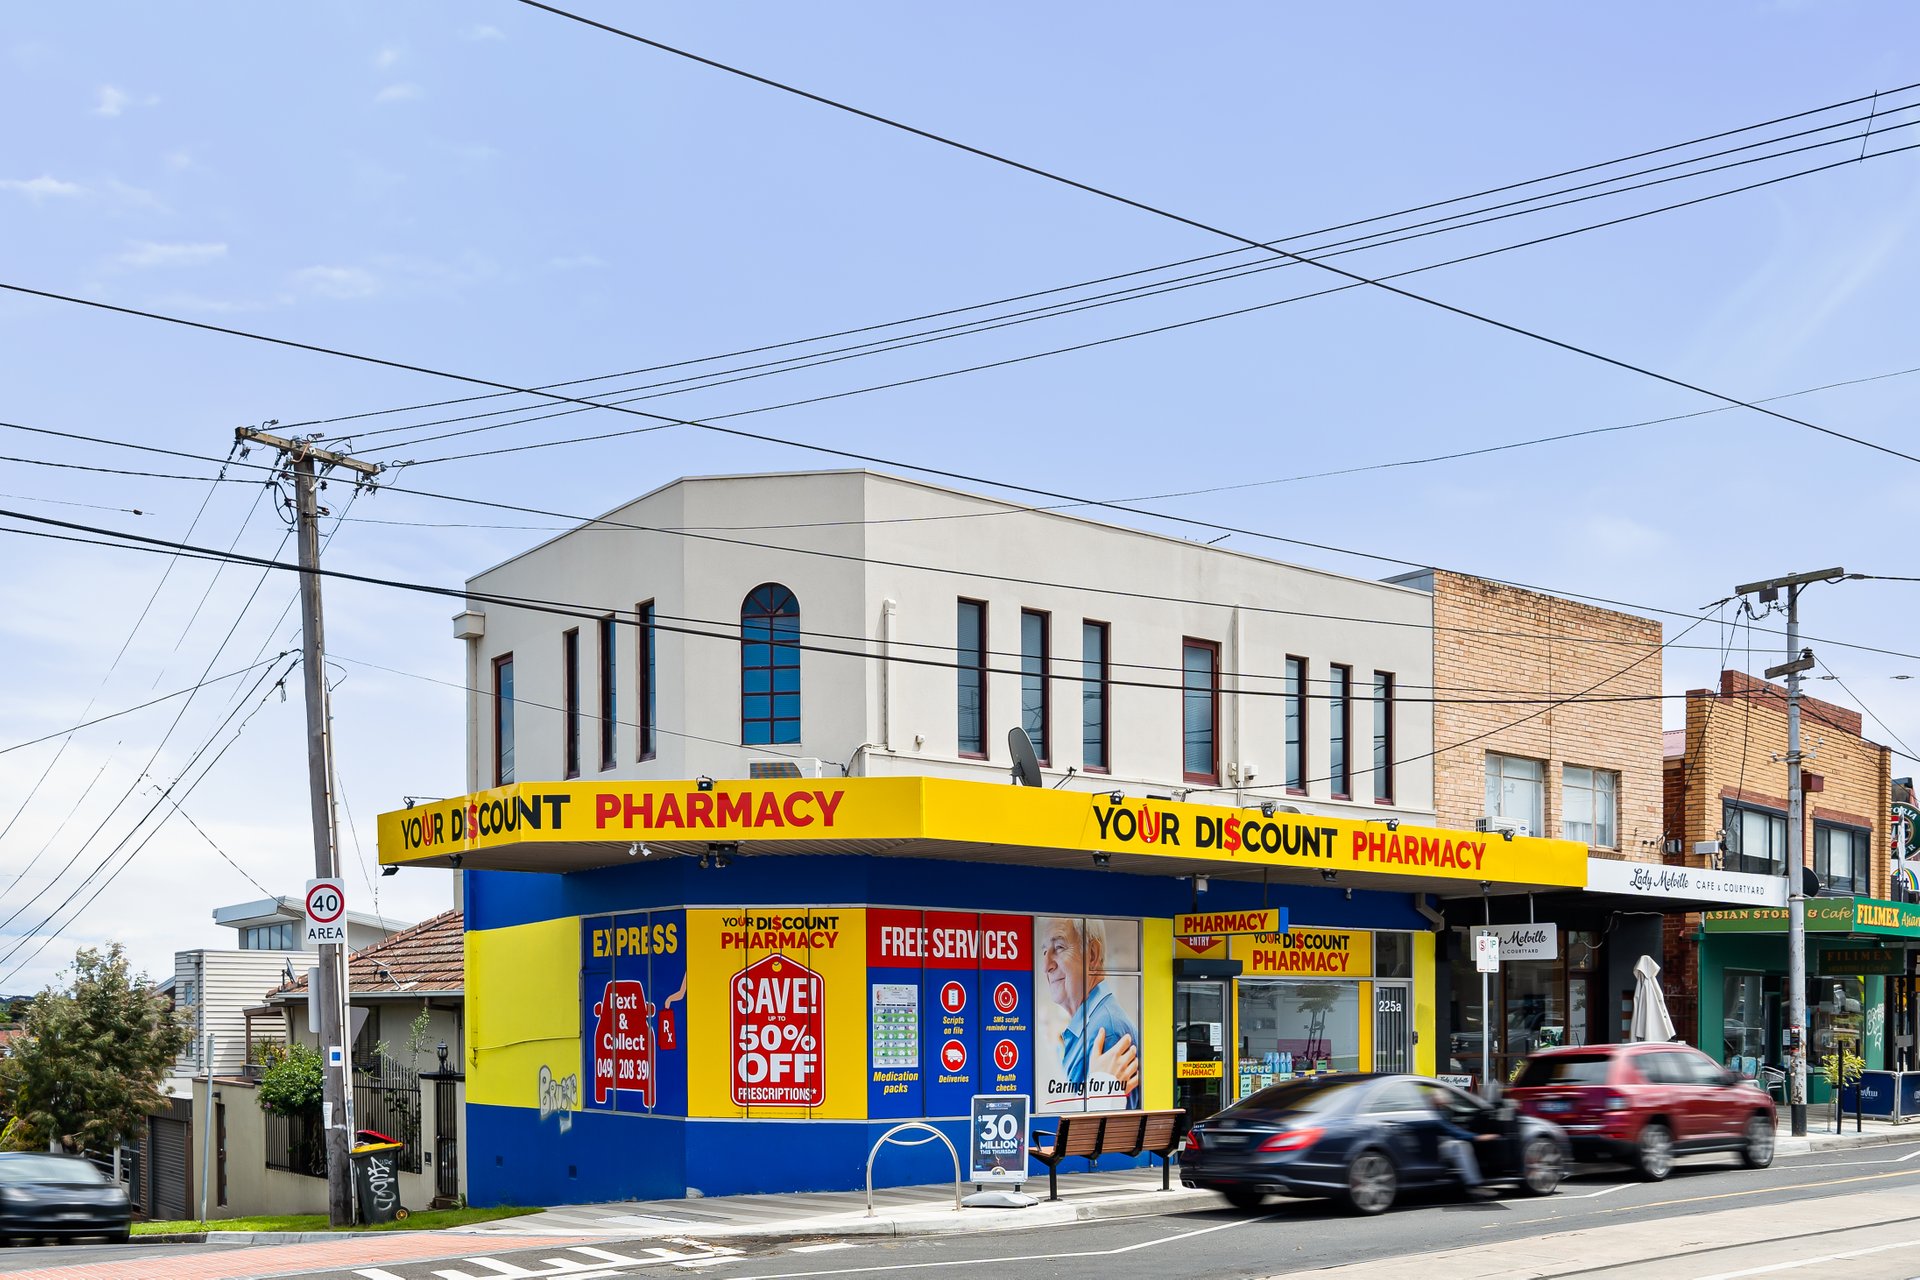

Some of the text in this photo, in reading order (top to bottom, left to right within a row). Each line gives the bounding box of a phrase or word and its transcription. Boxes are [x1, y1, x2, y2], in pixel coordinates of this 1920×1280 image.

[401, 810, 443, 850] YOUR
[596, 791, 845, 829] PHARMACY
[1891, 806, 1917, 820] ORIA
[1093, 804, 1180, 846] YOUR
[1352, 830, 1487, 871] PHARMACY
[1629, 868, 1652, 890] Lady
[1653, 871, 1689, 892] Melville
[1696, 880, 1714, 891] CAFE
[1723, 883, 1765, 896] COURTYARD
[312, 895, 338, 912] 40
[722, 916, 754, 927] YOUR
[1706, 907, 1852, 920] ASIAN STOR & Cafe
[1857, 904, 1900, 928] FILIMEX
[1184, 912, 1268, 933] PHARMACY
[308, 927, 344, 940] AREA
[593, 923, 677, 957] EXPRESS
[721, 932, 839, 949] PHARMACY
[1189, 937, 1210, 947] ENTRY
[1504, 930, 1547, 946] Melville
[881, 926, 1018, 960] FREE SERVICES
[1252, 950, 1350, 972] PHARMACY
[737, 977, 817, 1015] SAVE!
[1378, 1001, 1401, 1012] 225a
[619, 1013, 628, 1030] &
[943, 1016, 964, 1026] Scripts
[1005, 1016, 1019, 1024] script
[739, 1024, 816, 1051] 50%
[953, 1026, 963, 1035] file
[603, 1033, 645, 1050] Collect
[619, 1059, 634, 1079] 208
[738, 1053, 818, 1083] OFF
[873, 1071, 918, 1083] Medication
[938, 1074, 969, 1083] Deliveries
[997, 1073, 1016, 1082] Health
[883, 1083, 908, 1095] packs
[996, 1083, 1017, 1092] checks
[1048, 1078, 1128, 1096] Caring for you
[980, 1140, 1018, 1149] MILLION
